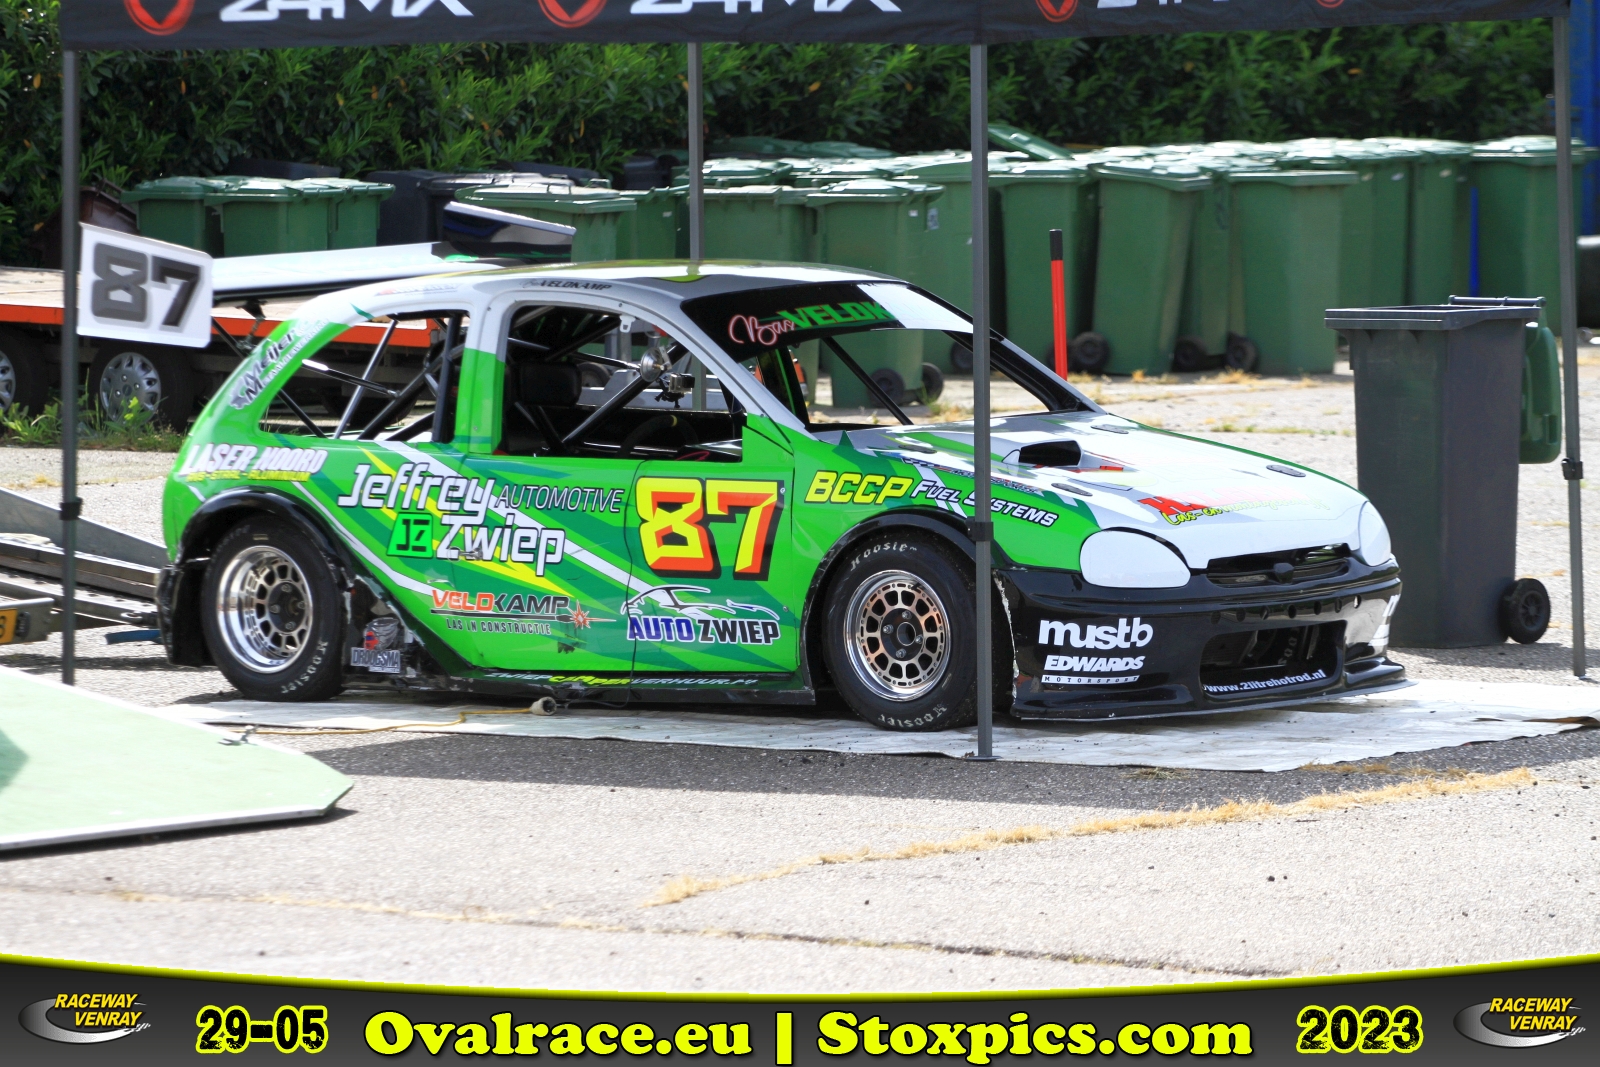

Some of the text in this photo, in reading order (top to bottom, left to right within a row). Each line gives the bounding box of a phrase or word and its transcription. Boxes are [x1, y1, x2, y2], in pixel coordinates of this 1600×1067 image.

[91, 242, 202, 328] 87
[728, 313, 796, 347] Bas
[179, 442, 329, 477] LASER NOORD
[338, 462, 626, 525] Jeffrey AUTOMOTIVE
[804, 470, 915, 506] BCCP
[962, 489, 1060, 528] SSTEMS
[436, 513, 566, 577] Zwiep
[635, 476, 785, 581] 87
[432, 589, 571, 614] VELDKAMP
[445, 618, 465, 631] LAS
[480, 620, 552, 636] CONSTRUCTIE
[627, 616, 781, 645] AUTO ZWIEP
[1038, 617, 1154, 650] mustb
[352, 648, 400, 667] DROOGSMA
[1043, 655, 1145, 673] EDWARDS
[1042, 675, 1139, 685] MOTORSPORT
[1204, 669, 1327, 693] www.2litrehotrod.nl
